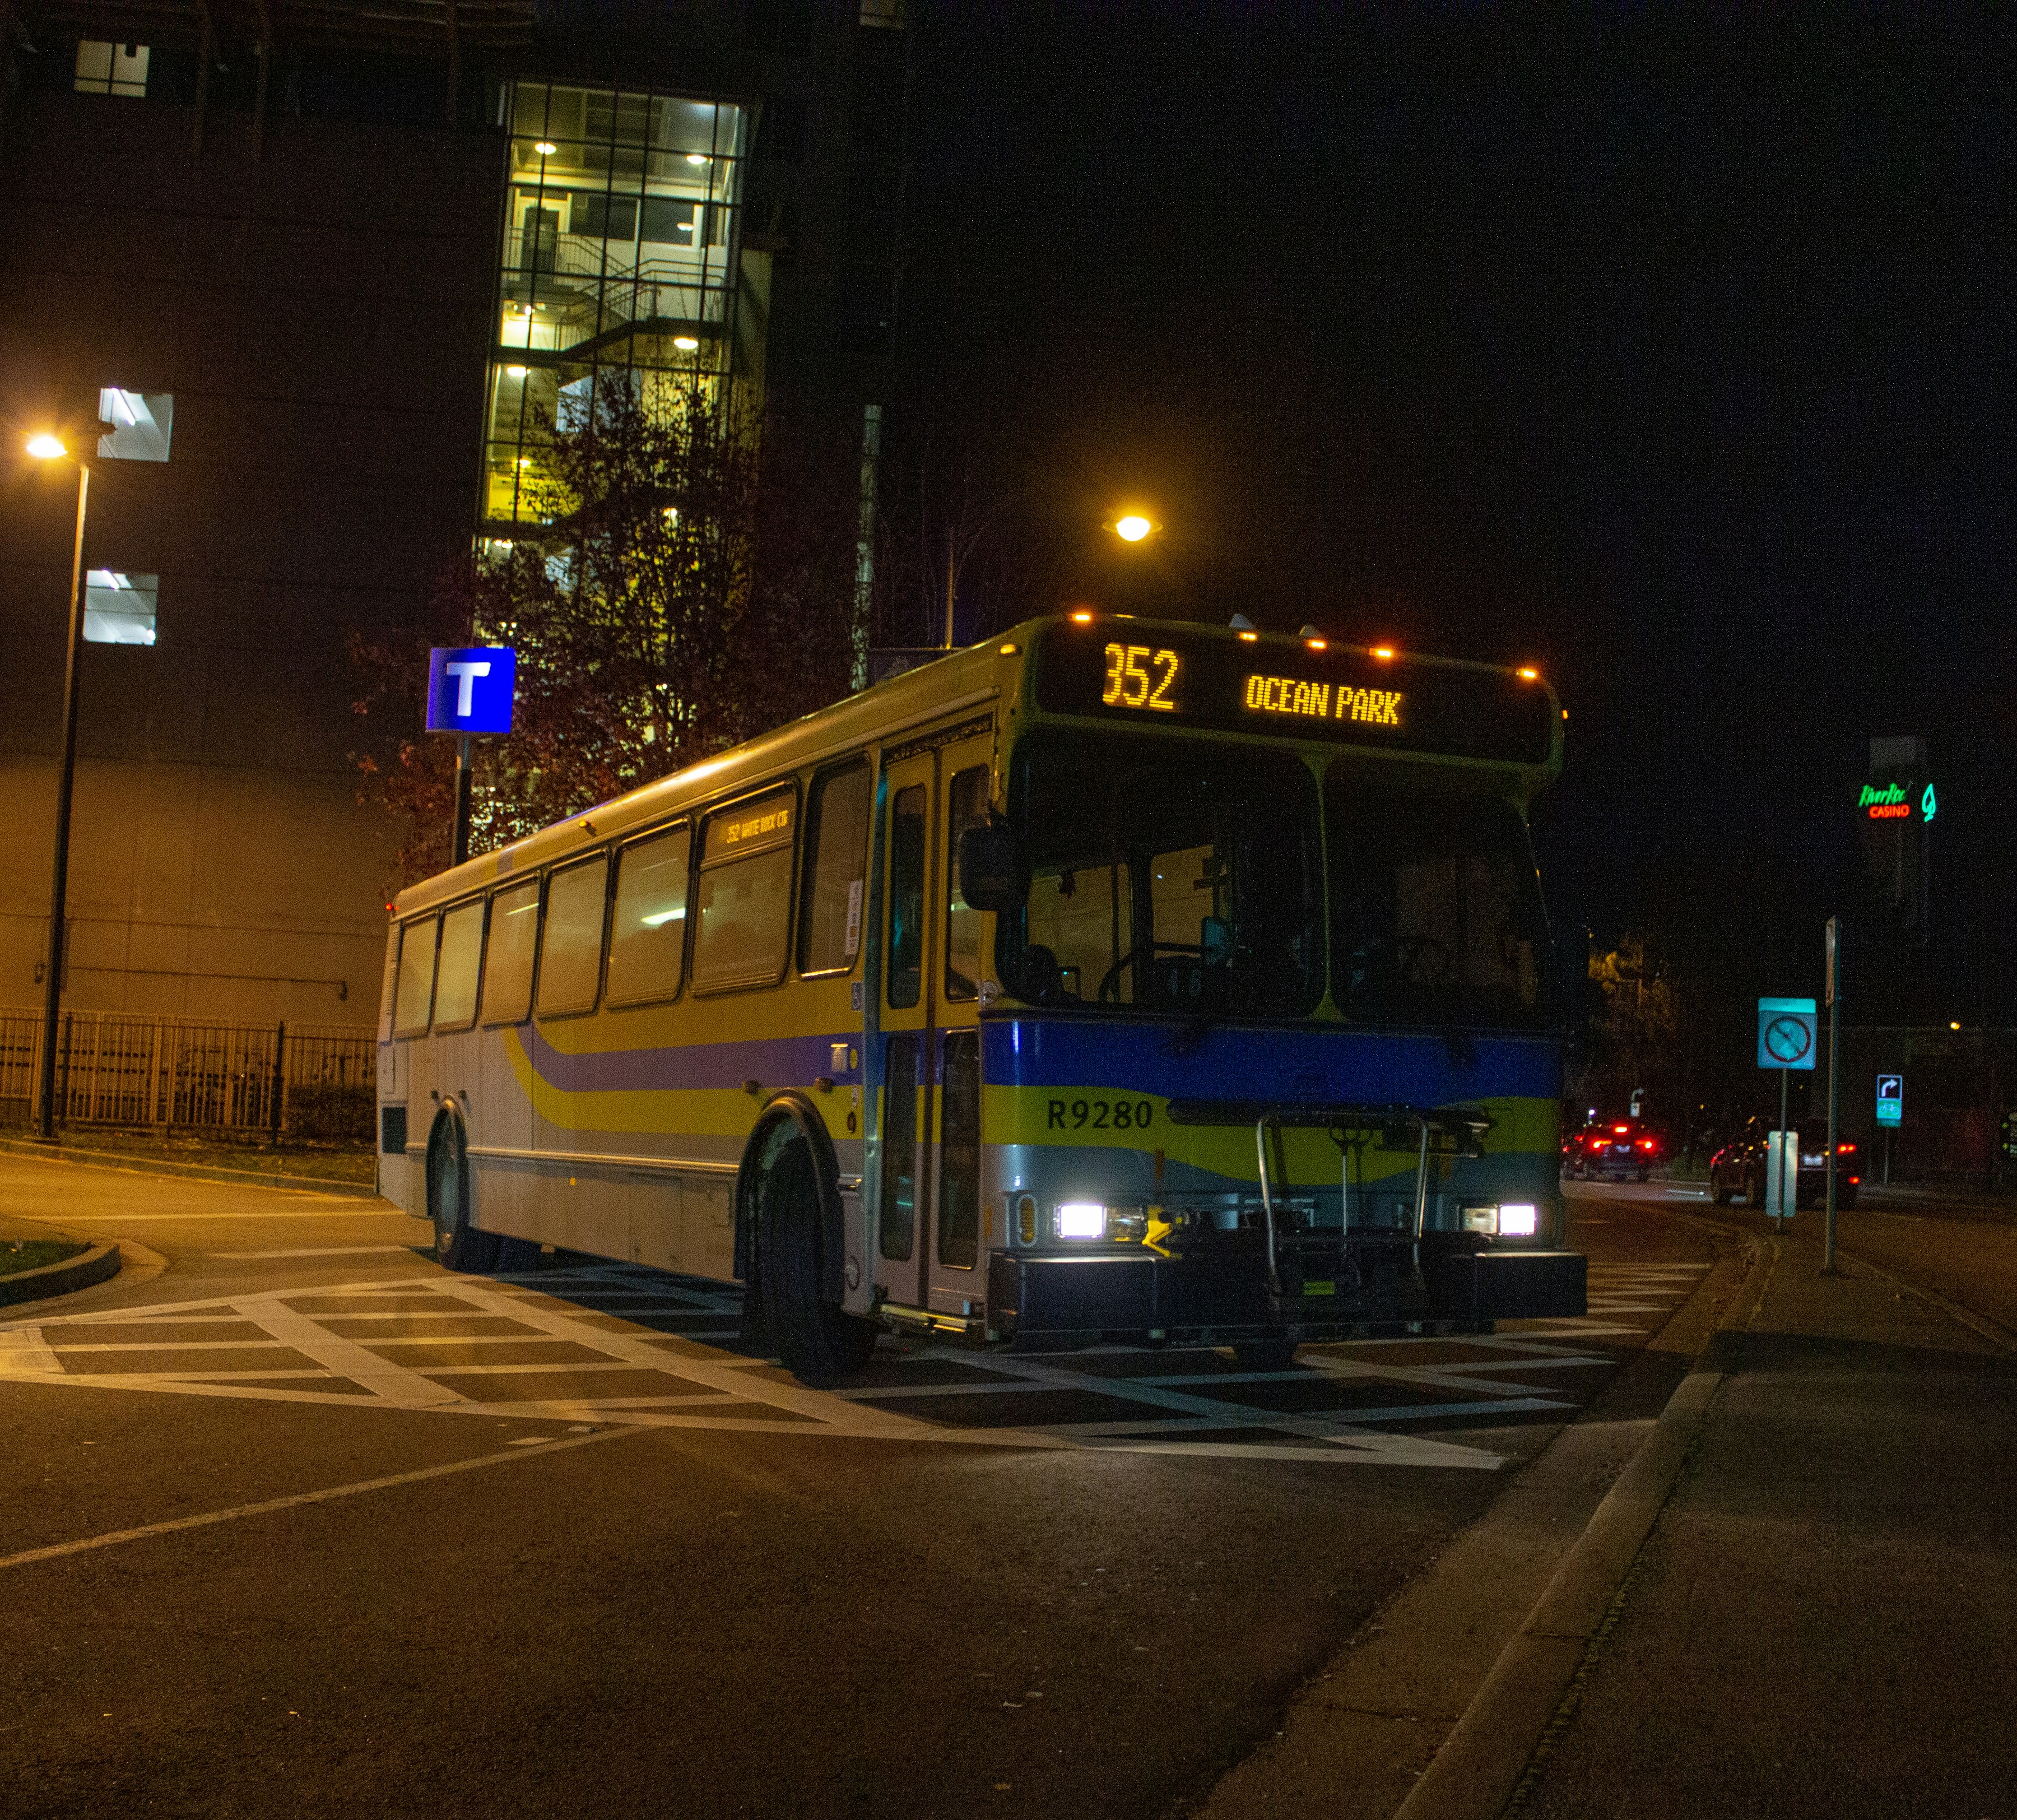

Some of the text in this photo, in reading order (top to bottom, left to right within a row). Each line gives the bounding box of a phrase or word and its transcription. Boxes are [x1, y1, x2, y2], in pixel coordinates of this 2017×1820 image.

[447, 662, 491, 717] T
[1103, 643, 1178, 710] 352
[1246, 675, 1401, 725] OCEAN PARK
[1869, 804, 1911, 819] CASINO
[1048, 1100, 1152, 1129] R9280
